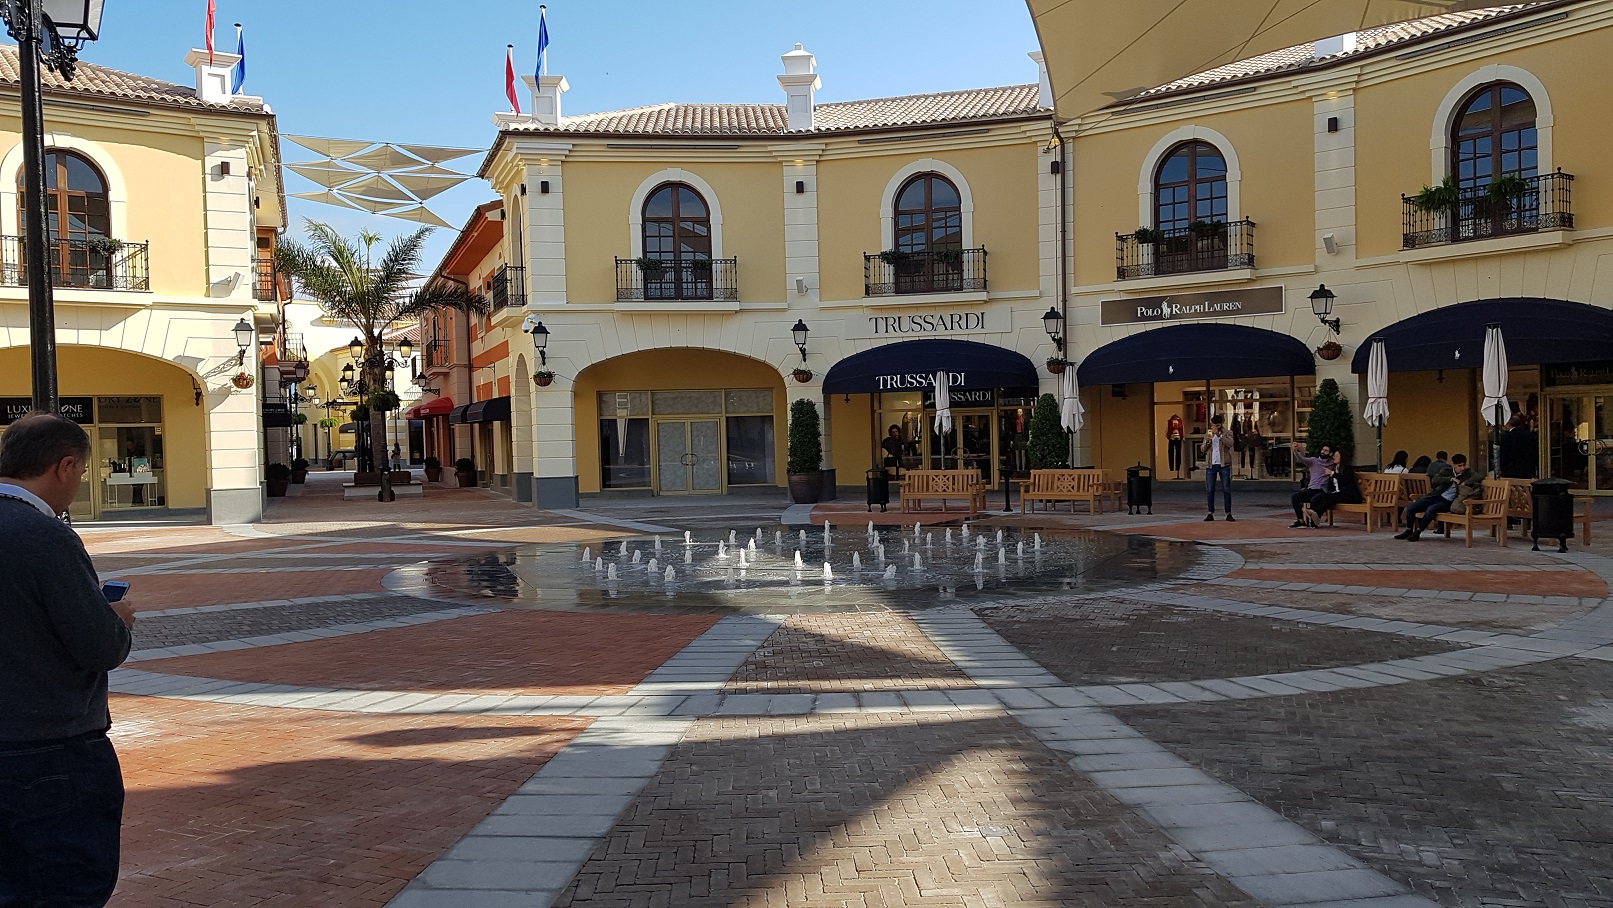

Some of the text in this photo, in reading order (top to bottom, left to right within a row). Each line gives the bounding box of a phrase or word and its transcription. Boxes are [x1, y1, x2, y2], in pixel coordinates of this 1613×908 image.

[1172, 303, 1203, 315] RALPH
[1204, 301, 1242, 312] LAUREN
[868, 312, 986, 334] TRUSSARDI
[875, 372, 965, 390] TRUSSADI
[928, 391, 991, 402] TSSARDI
[61, 404, 83, 413] ONE
